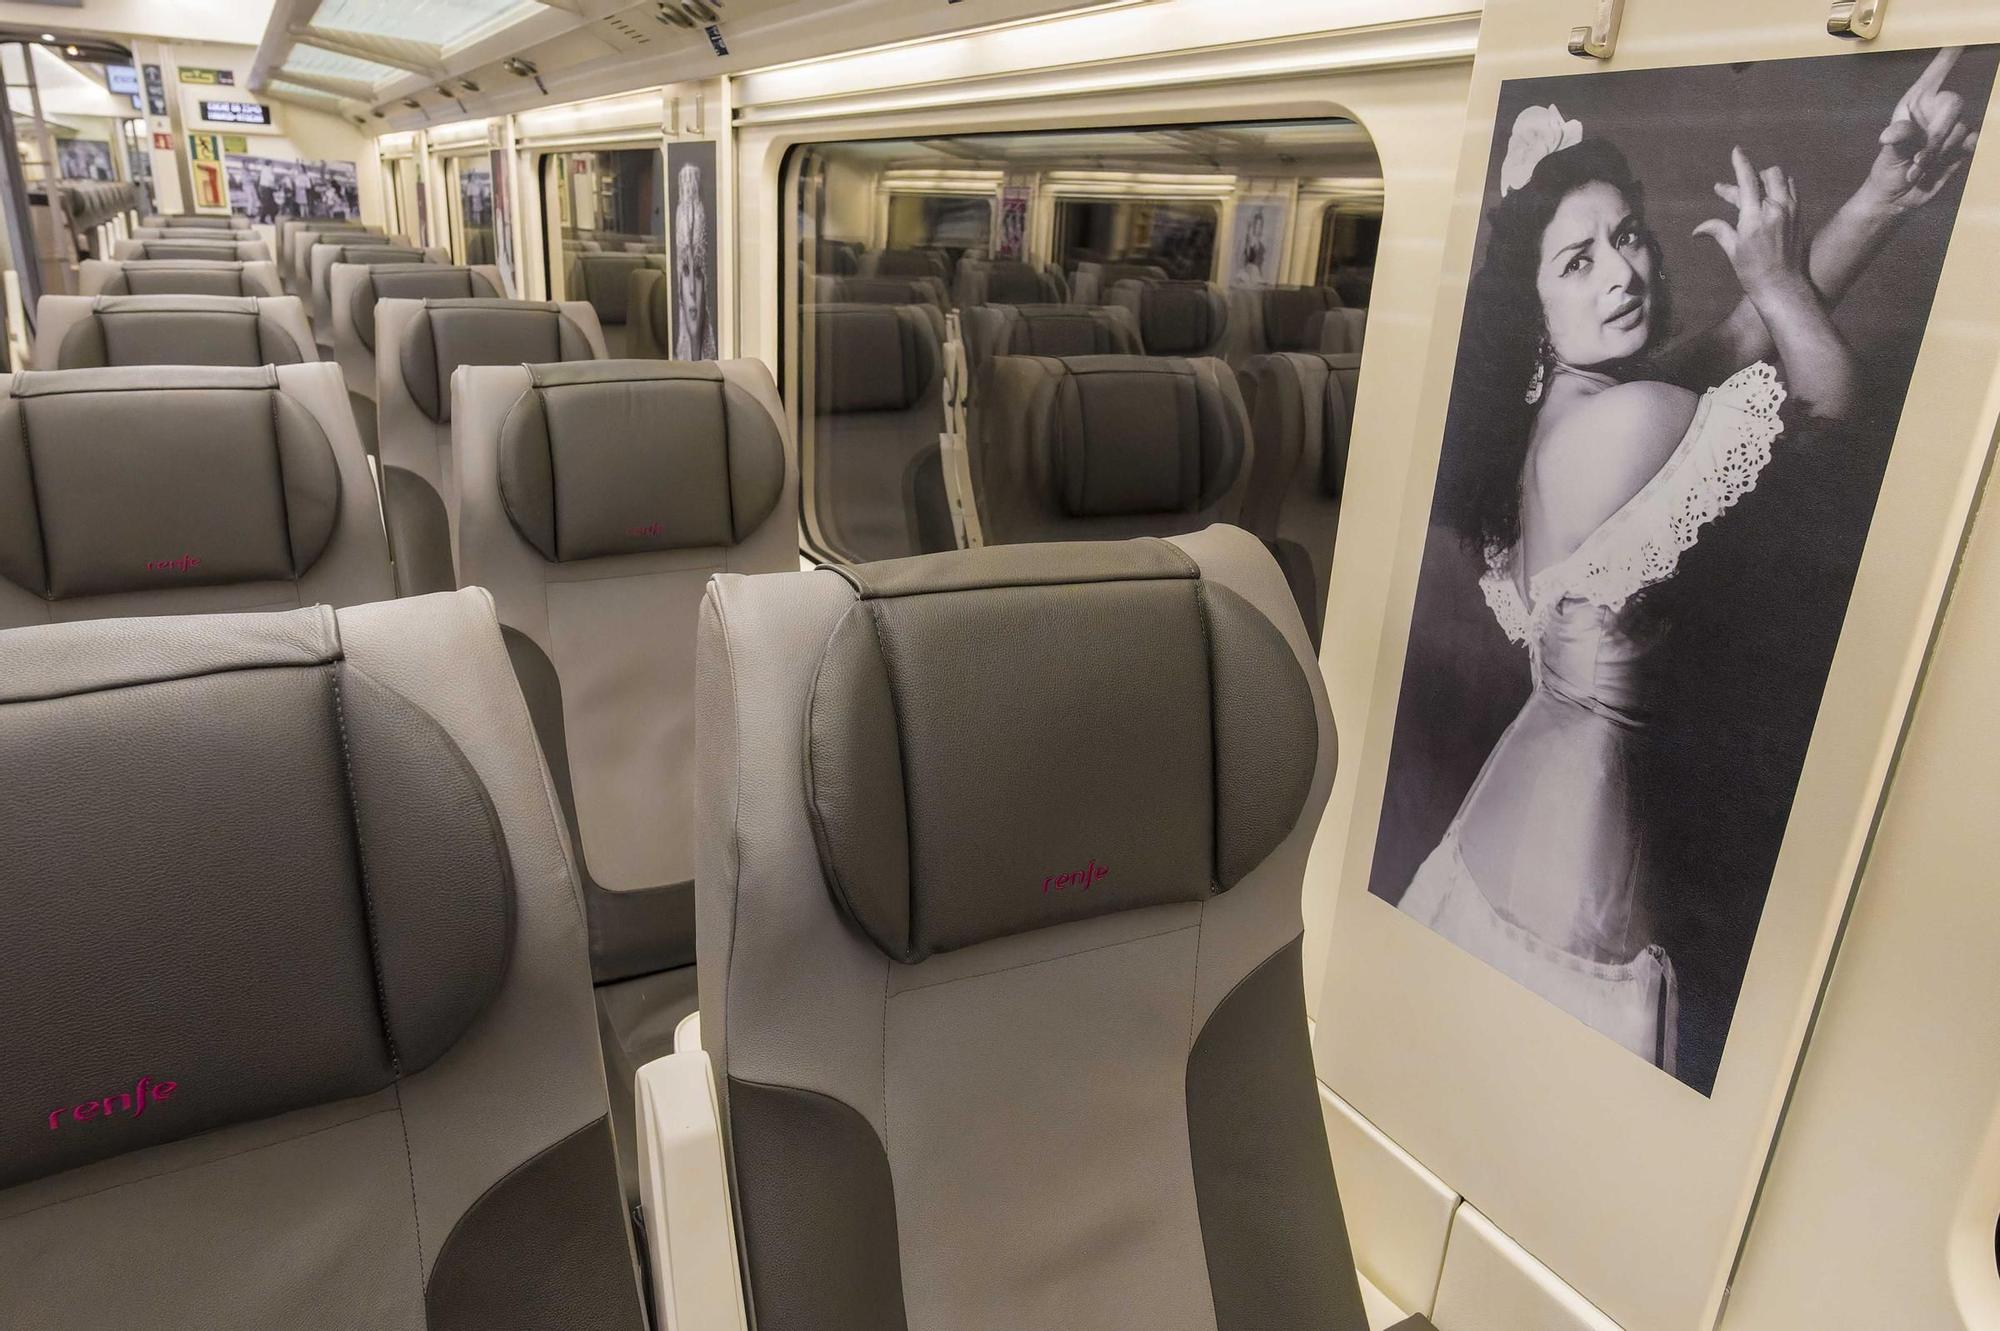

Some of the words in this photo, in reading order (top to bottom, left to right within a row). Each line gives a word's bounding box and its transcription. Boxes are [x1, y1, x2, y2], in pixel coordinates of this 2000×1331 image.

[146, 553, 200, 573] renfe
[1042, 860, 1109, 894] renfe
[48, 1076, 178, 1130] renfe
